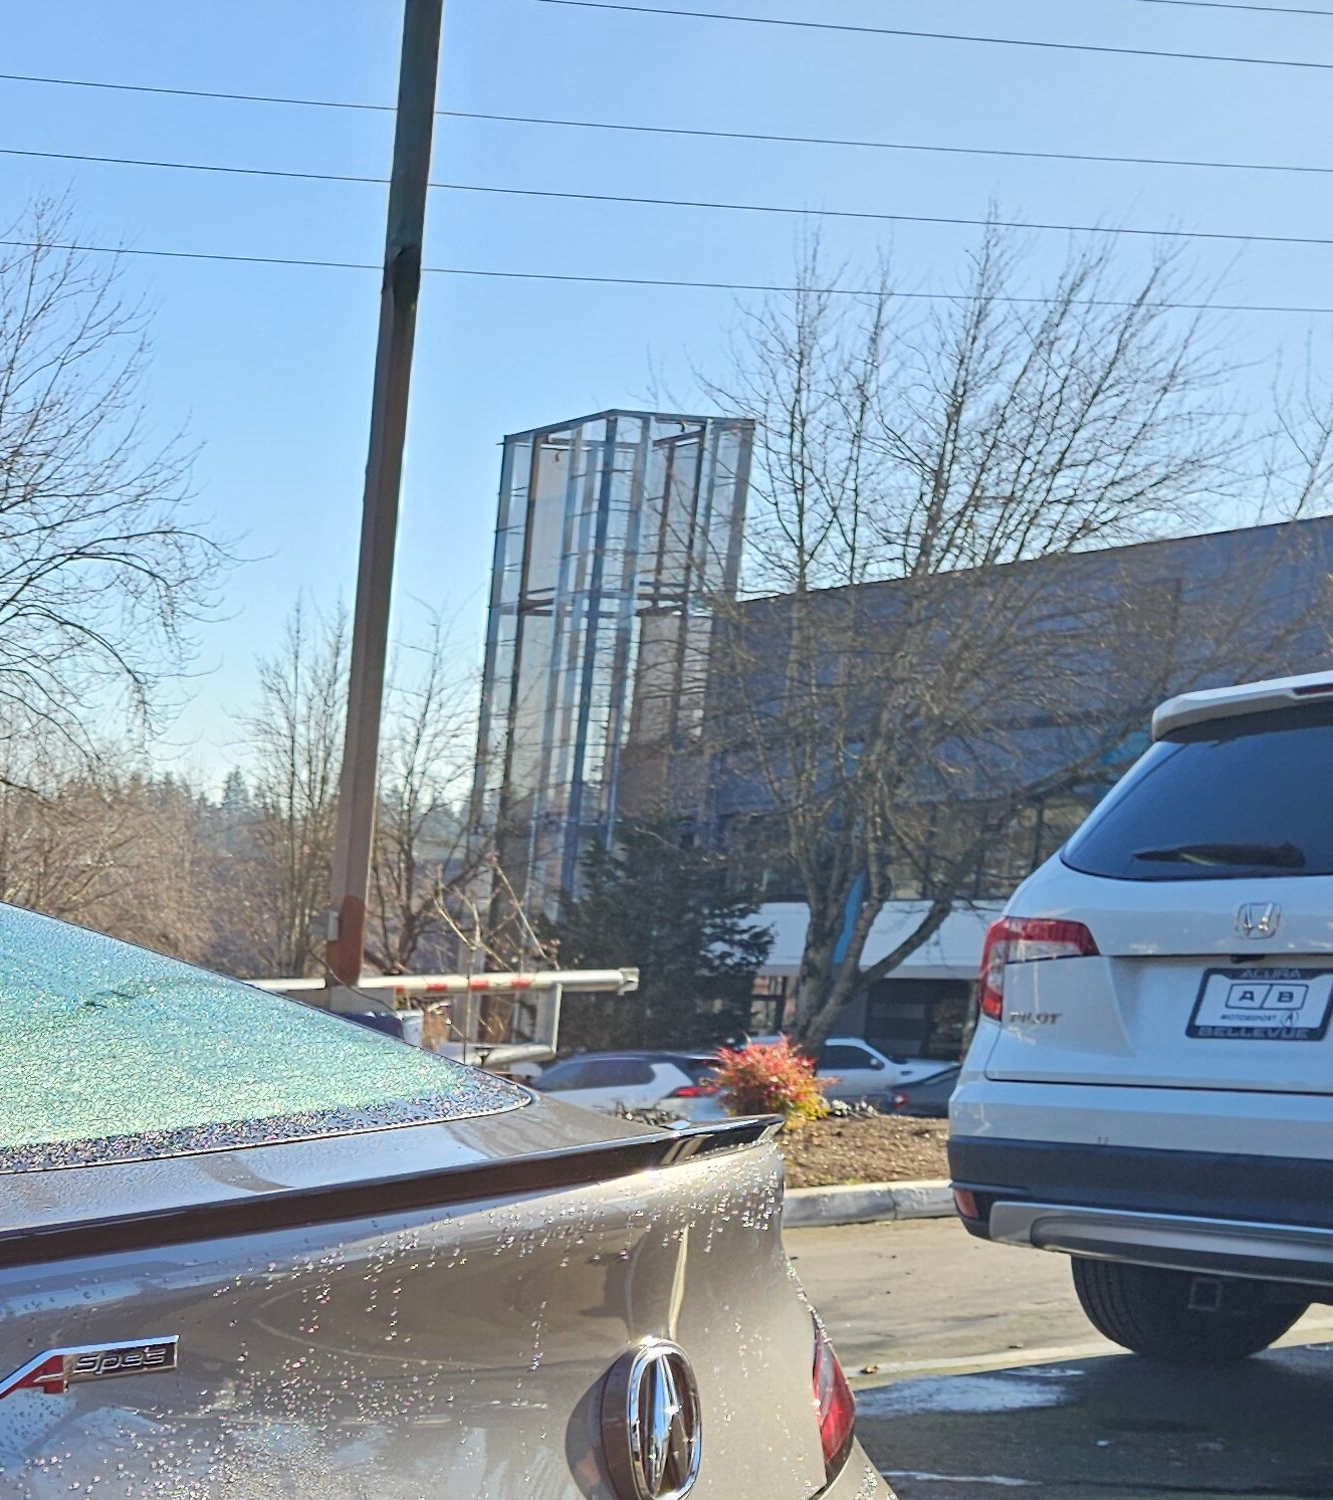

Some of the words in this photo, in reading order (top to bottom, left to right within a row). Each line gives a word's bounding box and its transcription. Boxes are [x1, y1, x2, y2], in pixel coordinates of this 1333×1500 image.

[1240, 968, 1302, 979] ACURA
[1238, 990, 1255, 1002] A
[1277, 991, 1295, 1003] B
[1009, 1011, 1063, 1025] PILOT
[1198, 1026, 1310, 1038] BELLEVUE
